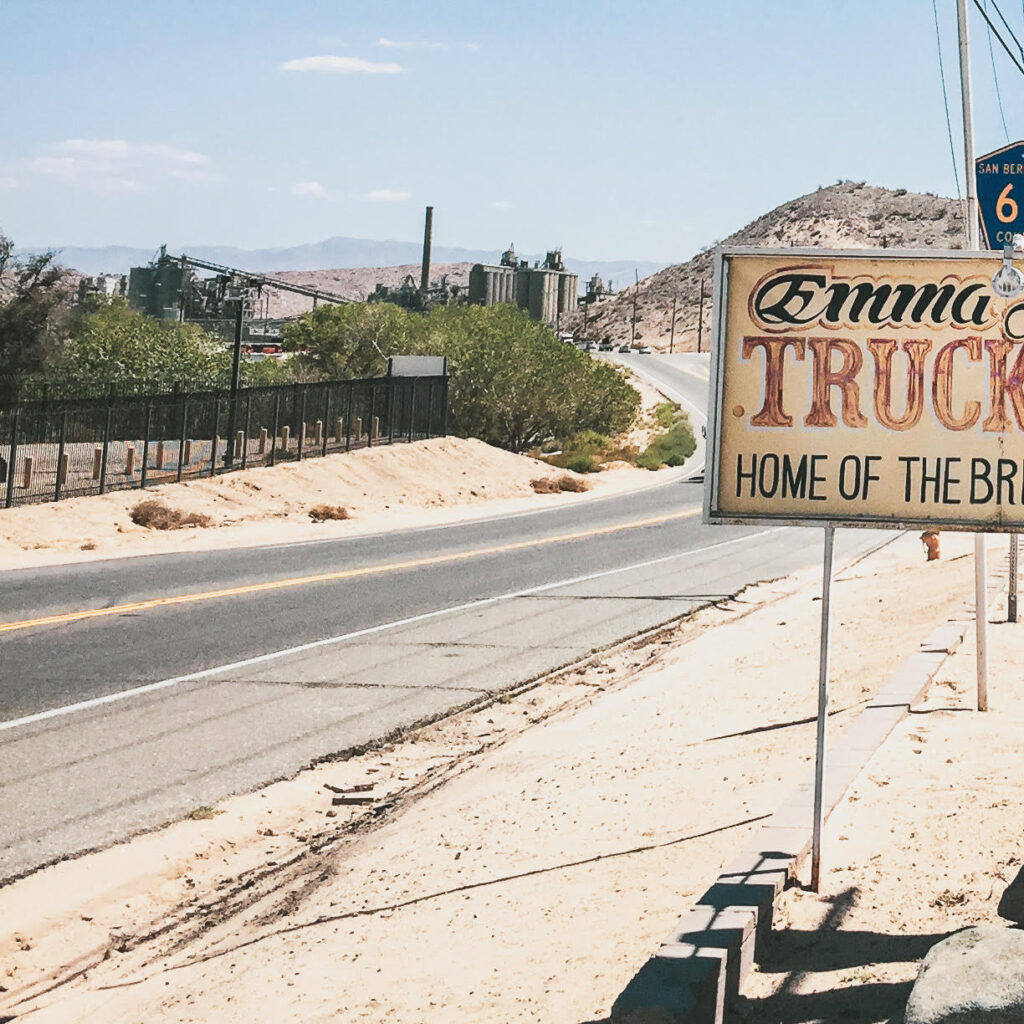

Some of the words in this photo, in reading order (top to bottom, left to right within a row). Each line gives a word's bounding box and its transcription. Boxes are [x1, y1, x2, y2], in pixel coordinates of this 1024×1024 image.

[978, 163, 999, 174] SAN
[754, 274, 990, 325] Emma
[736, 453, 828, 501] HOME
[838, 455, 882, 501] OF
[898, 456, 961, 504] THE
